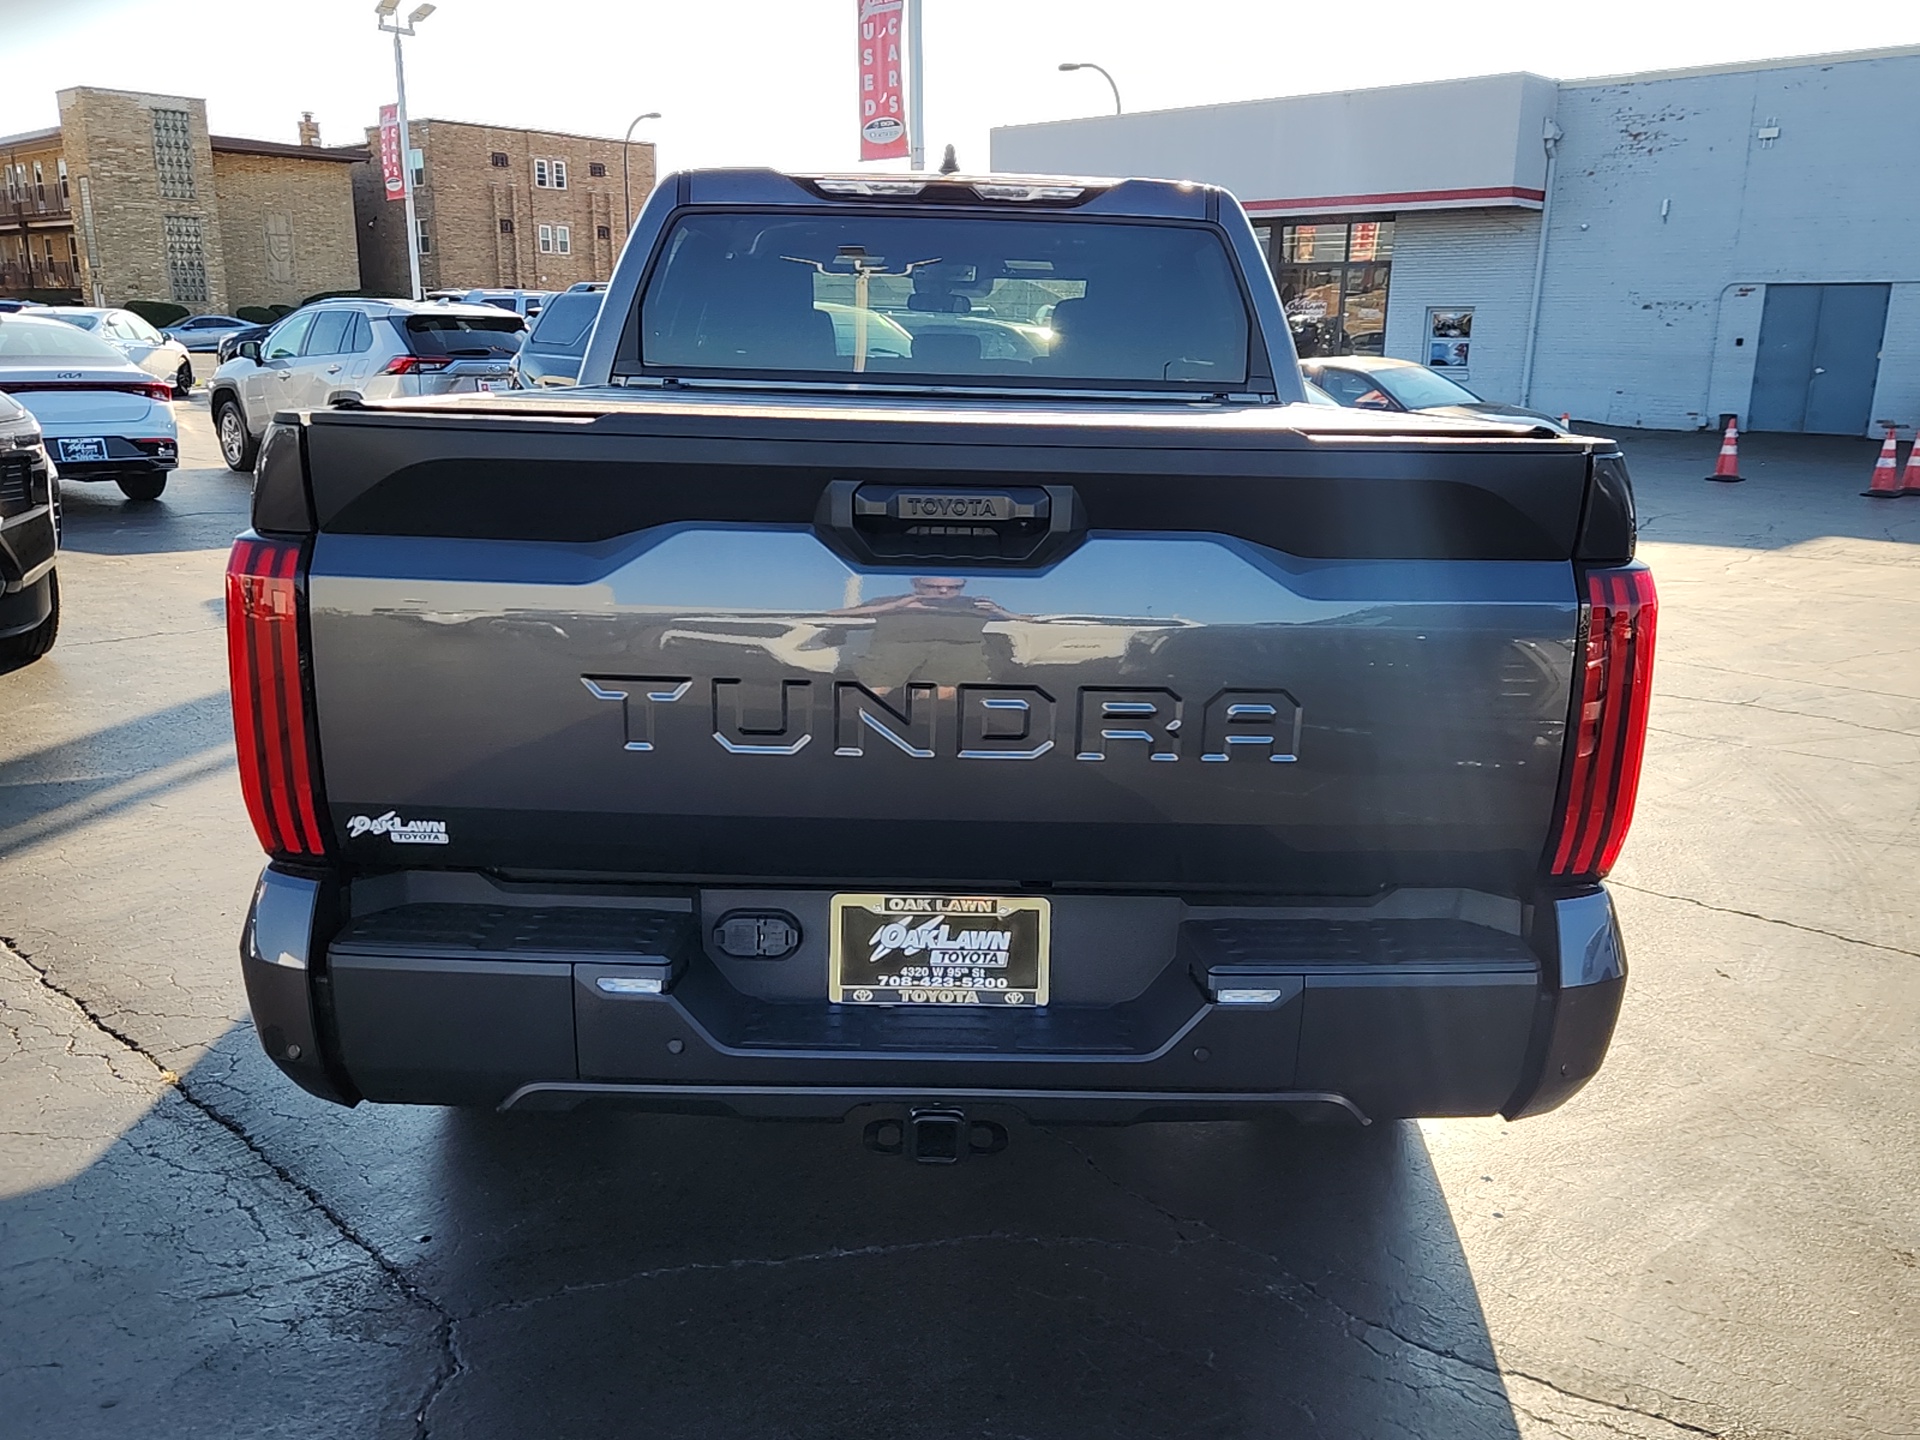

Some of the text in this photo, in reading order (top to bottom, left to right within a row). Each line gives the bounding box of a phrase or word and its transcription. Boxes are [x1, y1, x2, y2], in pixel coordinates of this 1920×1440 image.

[863, 22, 876, 116] USED
[381, 130, 390, 177] USED
[907, 497, 997, 517] TOYOTA
[580, 672, 1303, 763] TUNDRA
[399, 833, 440, 841] TOYOTA
[888, 898, 993, 913] OAK LAWN
[938, 951, 999, 965] TOYOTA
[900, 966, 986, 978] 4320 W 95th St
[877, 975, 1008, 989] 708-423-5200
[898, 989, 980, 1004] TOYOTA
